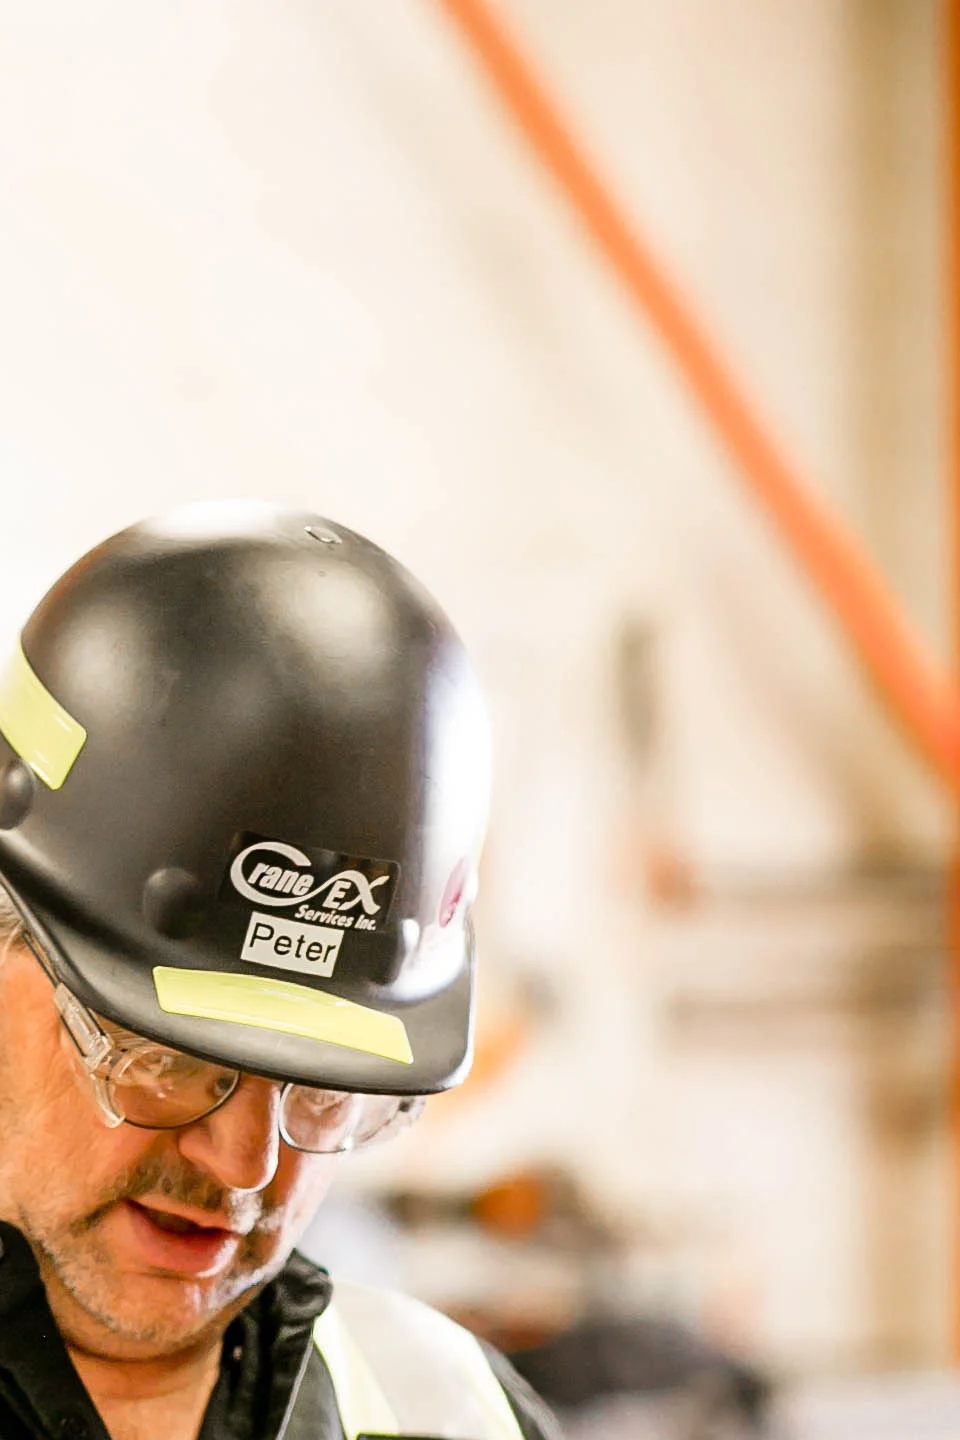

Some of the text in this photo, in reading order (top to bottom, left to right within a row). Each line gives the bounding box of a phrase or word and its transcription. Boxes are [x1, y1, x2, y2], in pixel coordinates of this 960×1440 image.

[230, 841, 315, 907] Crane
[294, 904, 377, 931] Services Inc.
[248, 922, 337, 964] Peter
